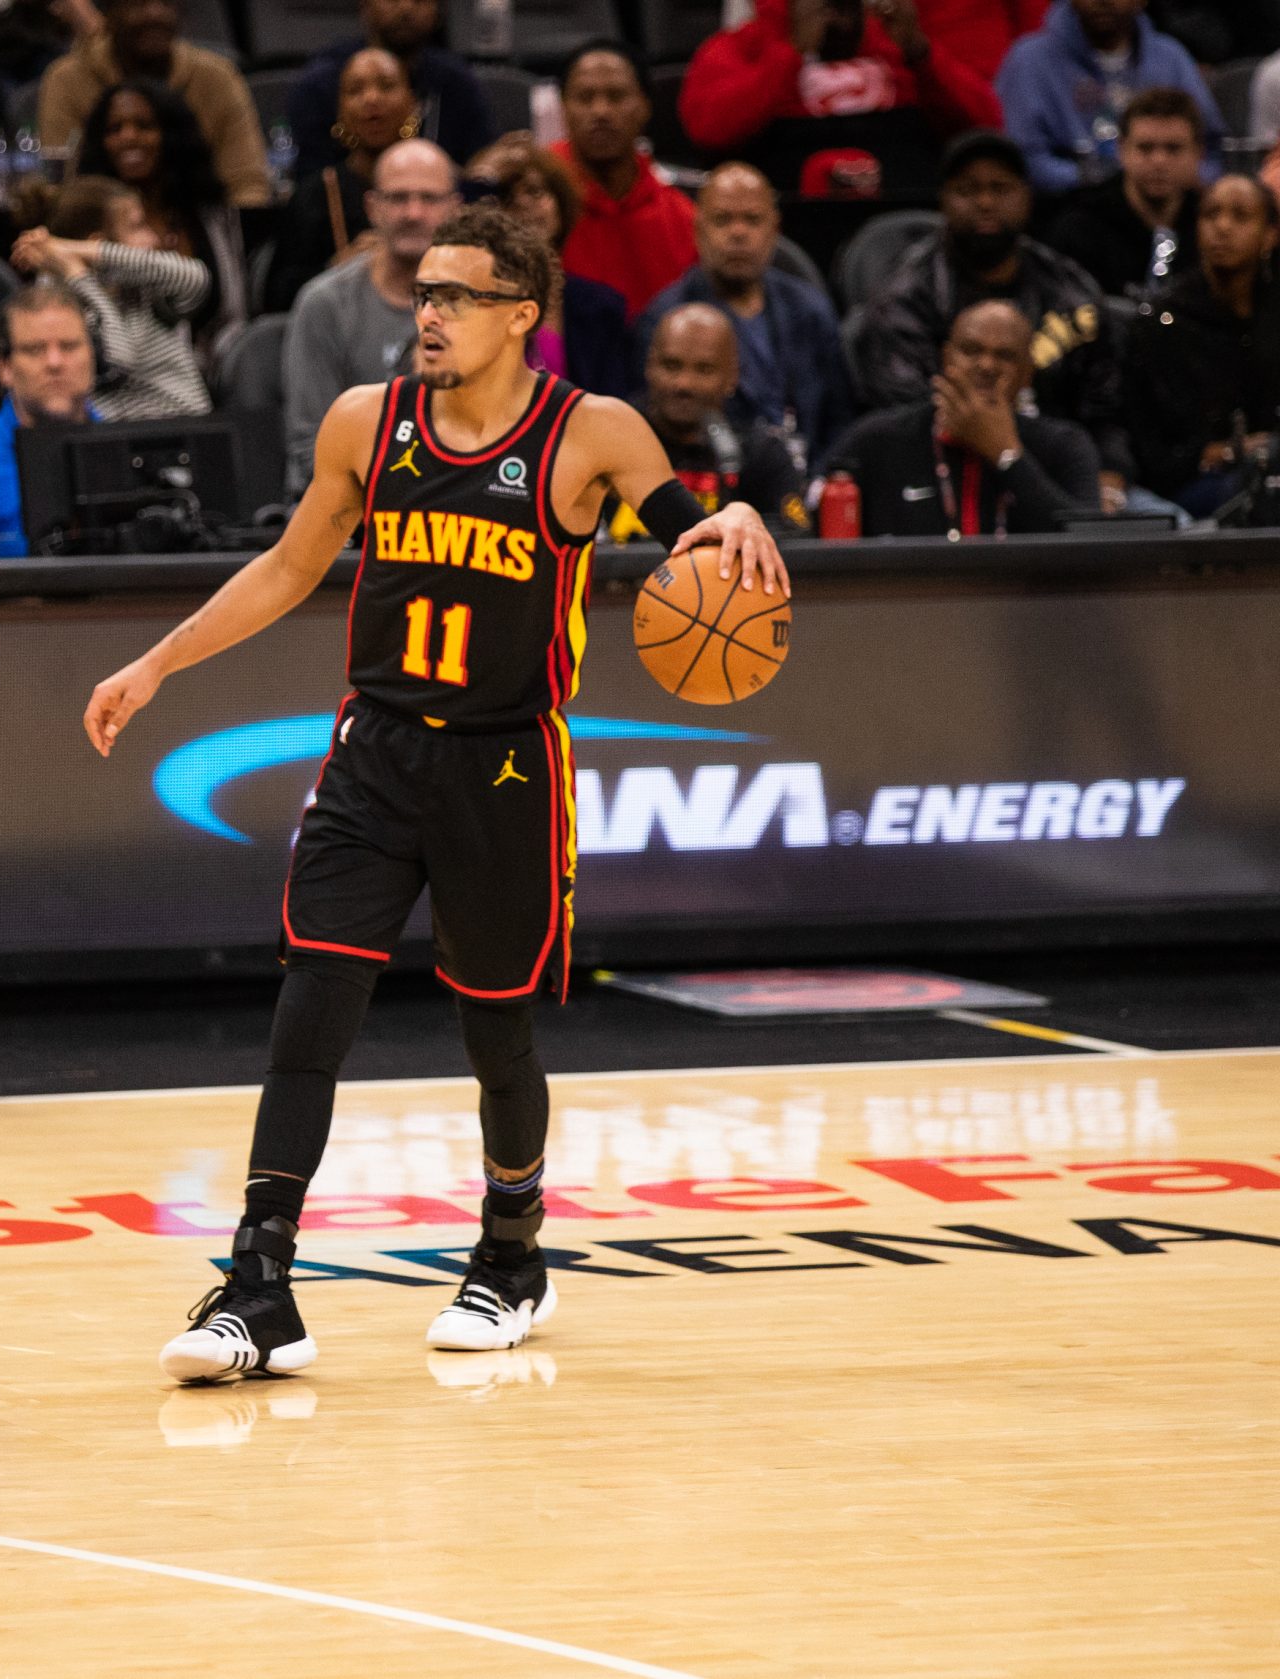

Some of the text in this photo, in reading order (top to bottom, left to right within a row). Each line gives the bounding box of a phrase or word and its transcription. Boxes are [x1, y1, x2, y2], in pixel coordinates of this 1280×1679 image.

[395, 420, 414, 442] 6
[373, 511, 536, 582] HAWKS
[402, 595, 472, 687] 11
[862, 777, 1186, 846] ENERGY
[850, 1153, 1280, 1203] Fa
[208, 1216, 1280, 1287] ARENA
